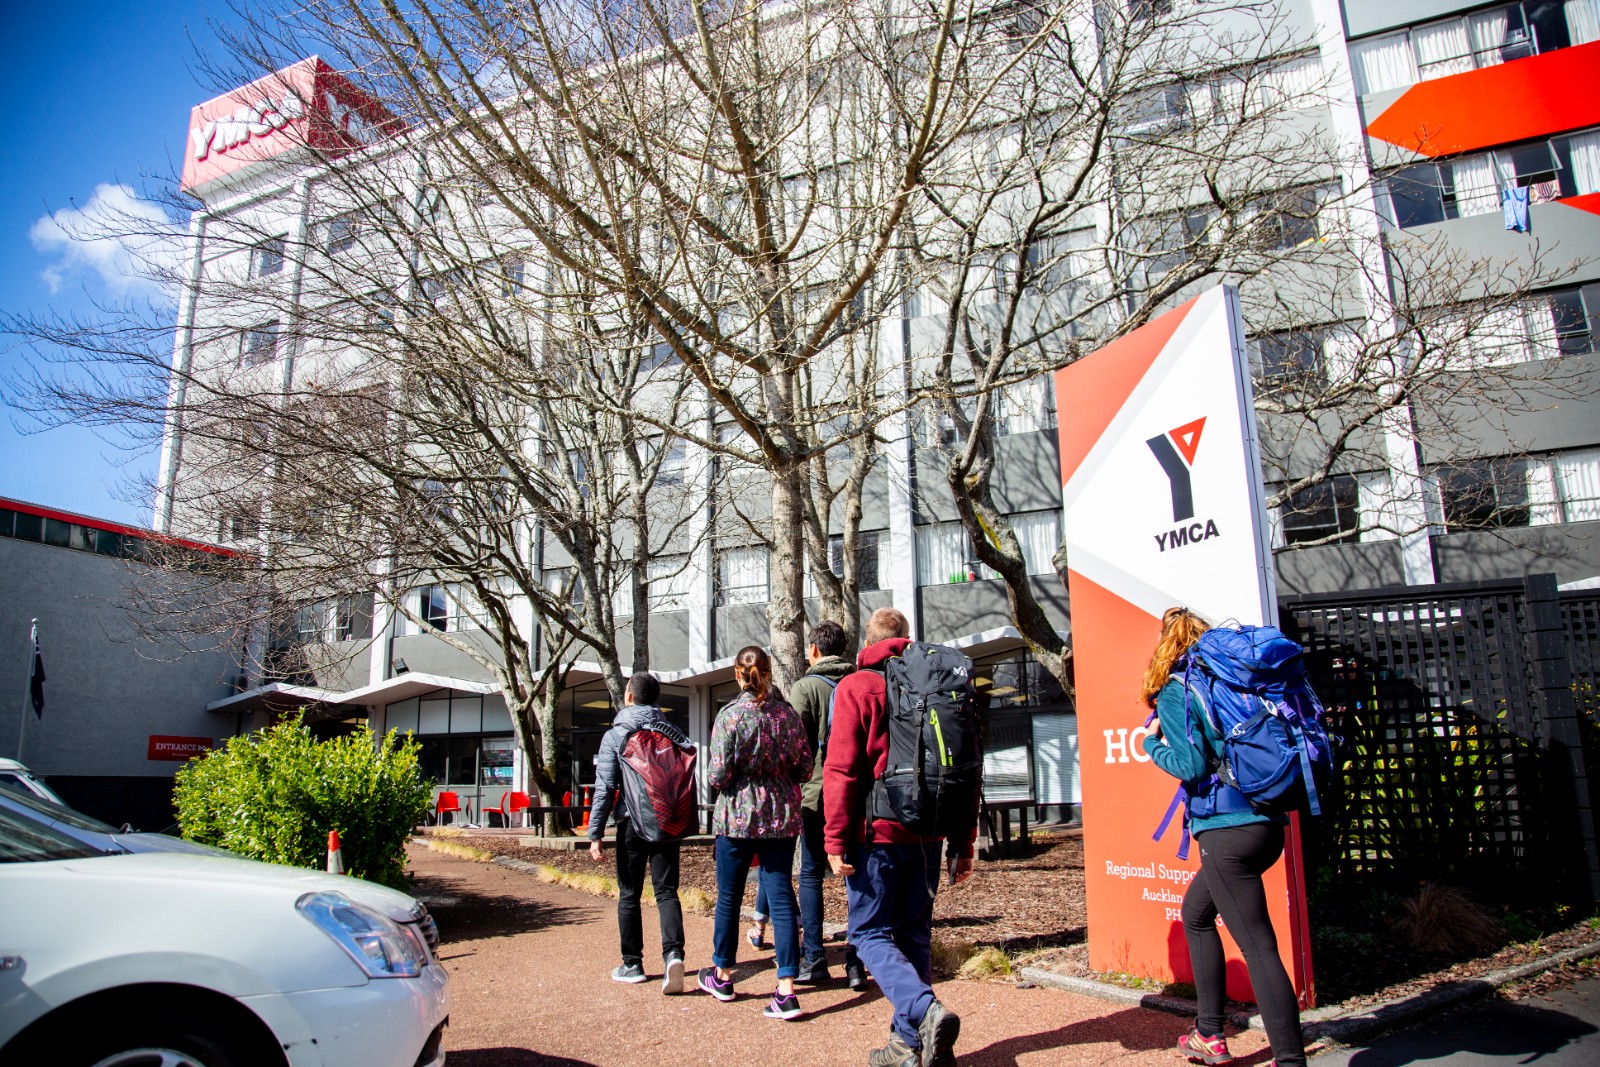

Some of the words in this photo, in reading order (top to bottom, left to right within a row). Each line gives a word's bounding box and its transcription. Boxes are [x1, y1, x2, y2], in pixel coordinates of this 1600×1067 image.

[190, 87, 306, 160] YMCA
[1154, 518, 1220, 552] YMCA
[155, 742, 197, 751] ENTRANCE
[1105, 860, 1155, 880] Regional
[1158, 864, 1197, 885] Suppo
[1142, 887, 1183, 904] Aucklan
